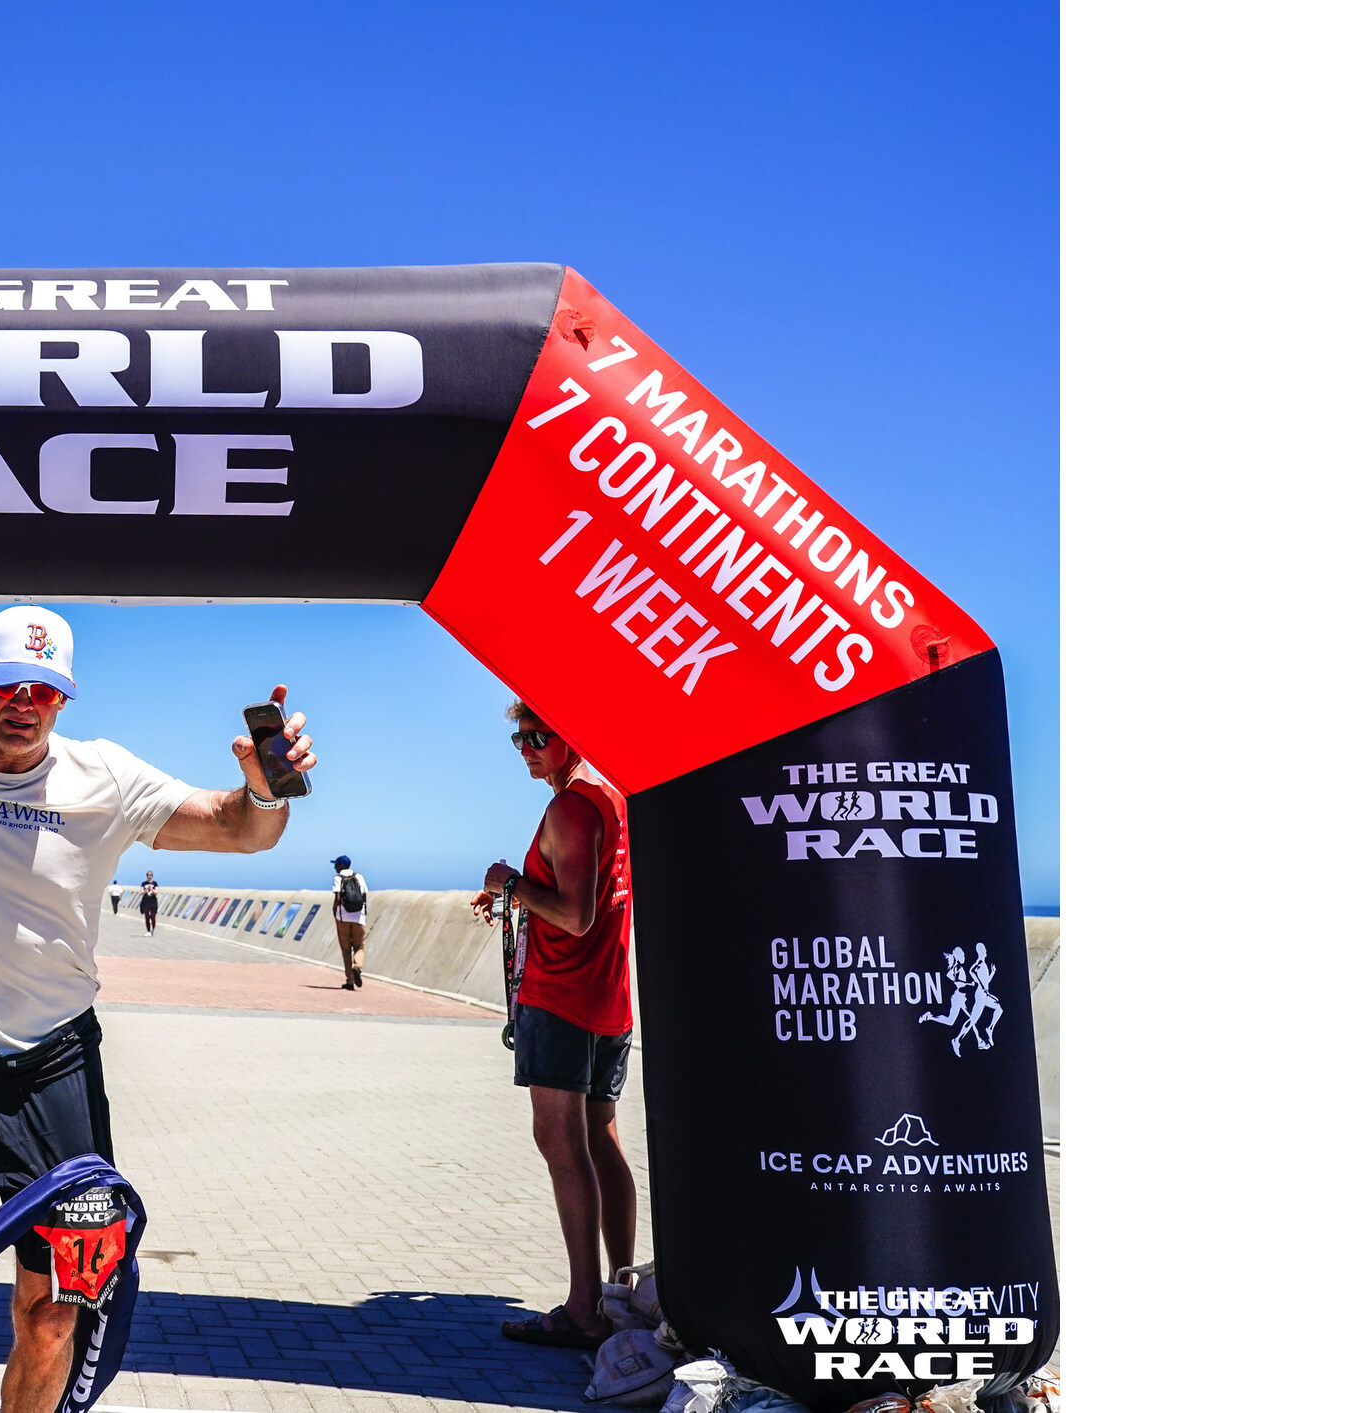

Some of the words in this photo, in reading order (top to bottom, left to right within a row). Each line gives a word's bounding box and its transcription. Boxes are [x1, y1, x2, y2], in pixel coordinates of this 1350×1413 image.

[587, 334, 638, 373] 7
[624, 369, 915, 629] MARATHONS
[526, 376, 592, 430] 7
[569, 416, 874, 692] CONTINENTS
[538, 510, 593, 566] 1
[574, 538, 739, 696] WEEK
[25, 623, 47, 651] B
[782, 762, 859, 786] THE
[866, 761, 971, 785] GREAT
[740, 790, 999, 825] WORLD
[785, 827, 979, 861] RACE
[771, 935, 896, 970] GLOBAL
[772, 971, 943, 1005] MARATHON
[775, 1009, 857, 1042] CLUB
[759, 1151, 803, 1173] ICE
[812, 1153, 873, 1175] CAP
[881, 1151, 1029, 1176] ADVENTURES
[810, 1181, 932, 1194] ANTARCTICA
[943, 1181, 1001, 1193] AWAITS
[64, 1212, 111, 1223] RAC
[73, 1237, 105, 1275] 16
